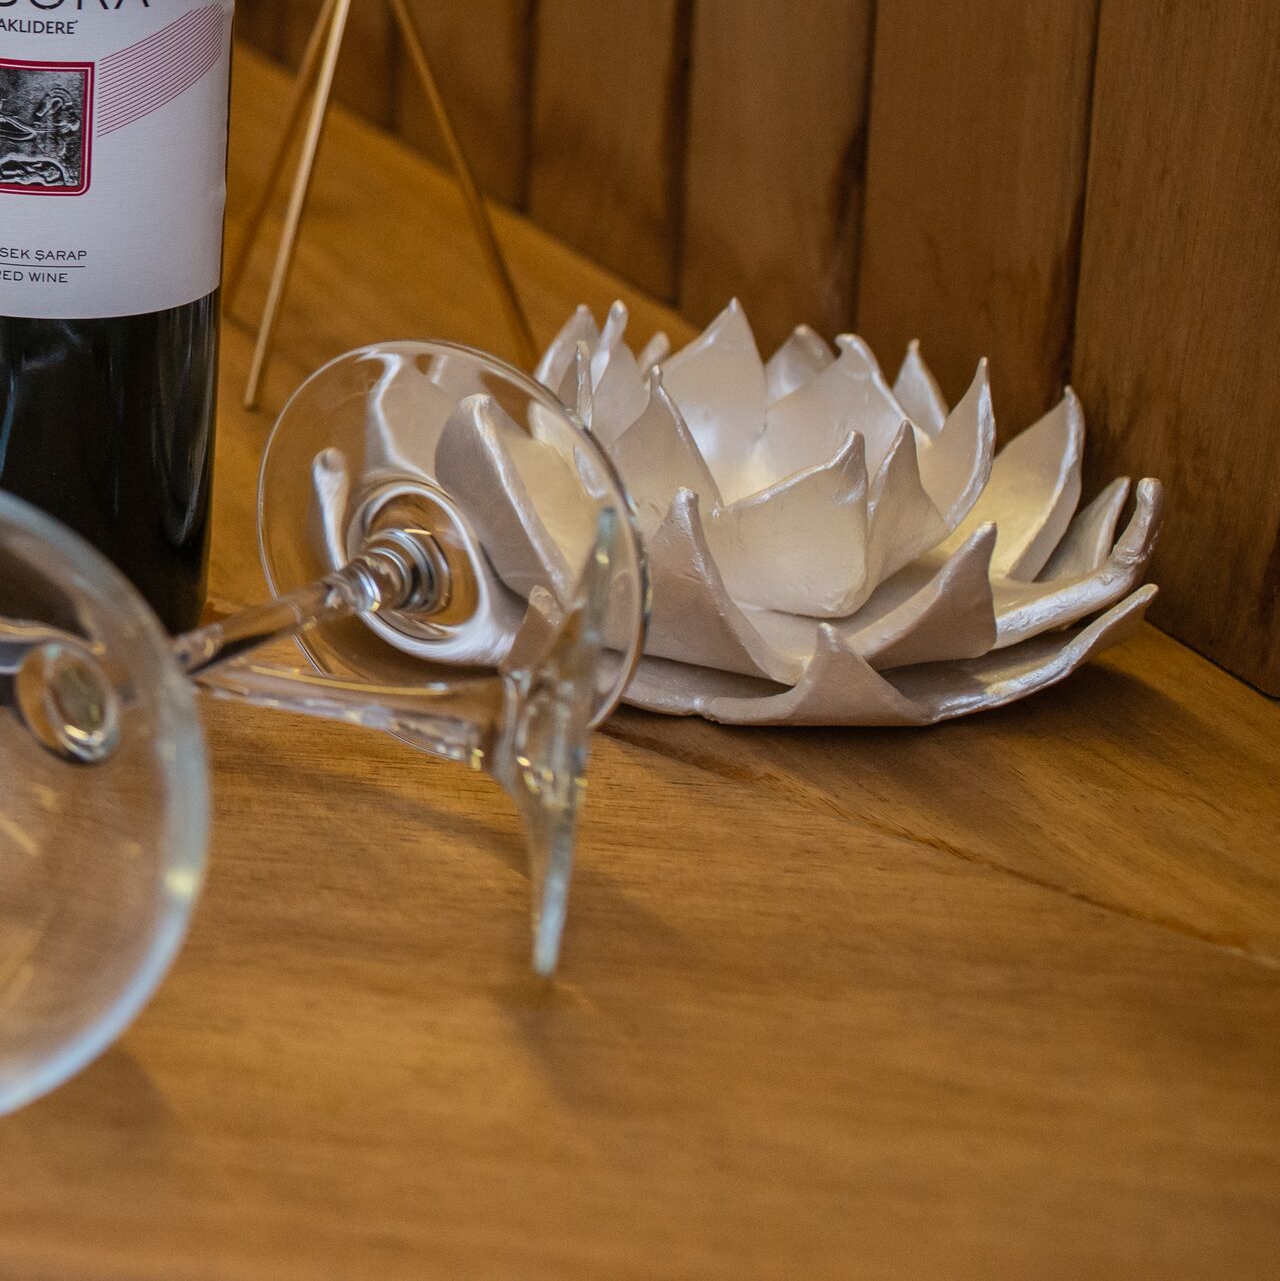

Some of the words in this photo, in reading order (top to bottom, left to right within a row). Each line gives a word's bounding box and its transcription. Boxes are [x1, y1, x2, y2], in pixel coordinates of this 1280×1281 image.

[0, 247, 30, 259] SEK
[35, 249, 88, 261] ŞARAP
[28, 272, 68, 283] WINE
